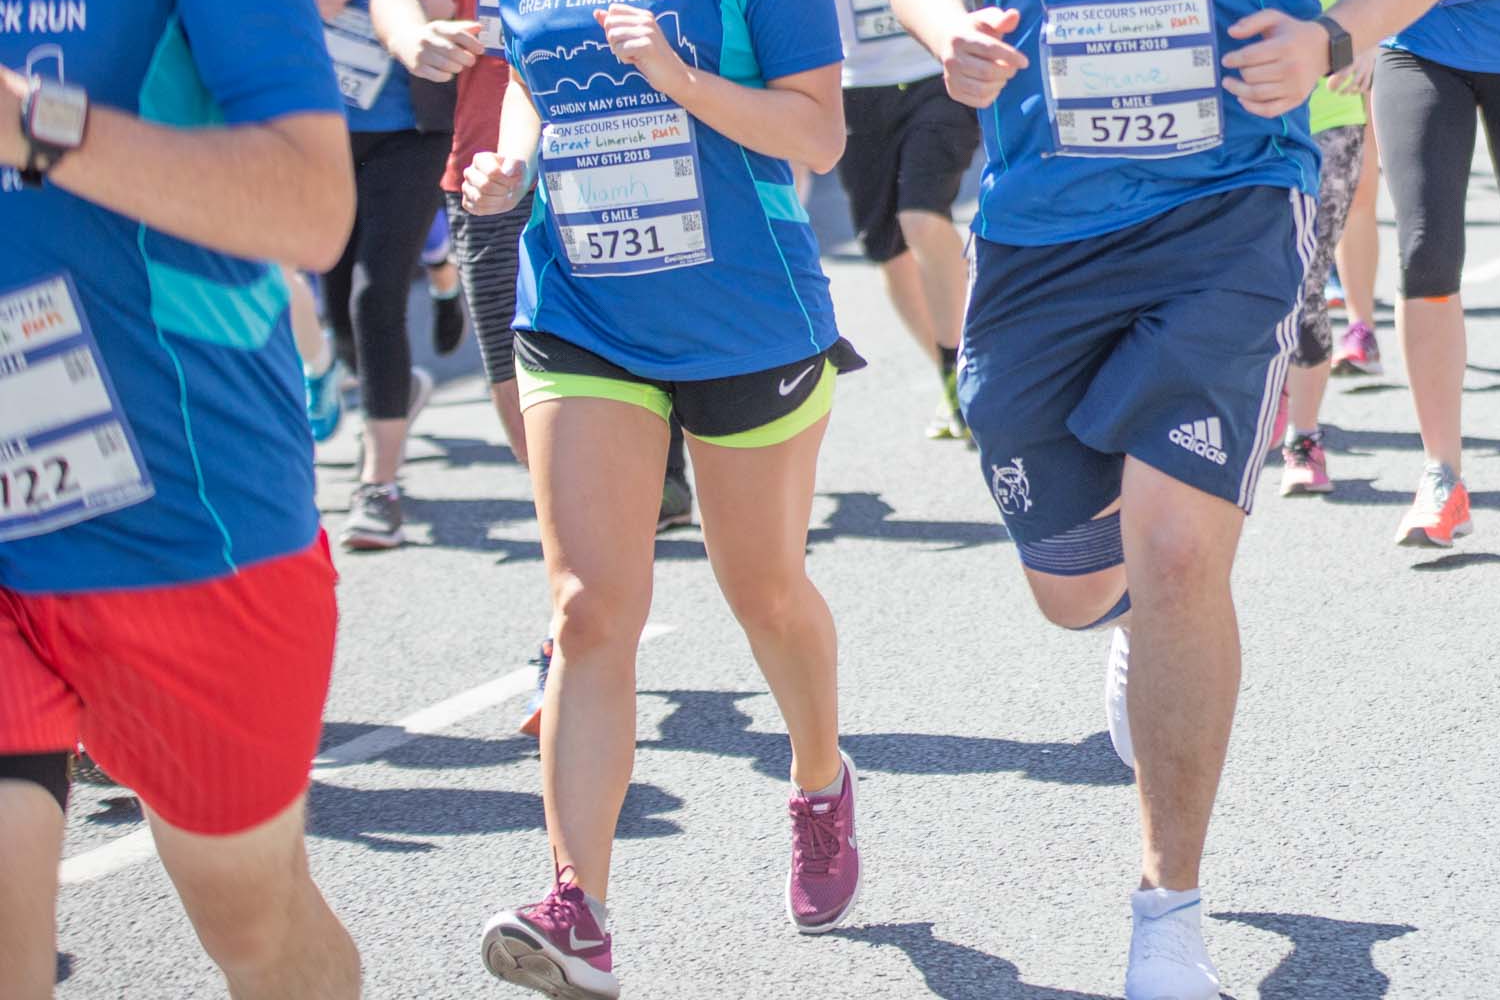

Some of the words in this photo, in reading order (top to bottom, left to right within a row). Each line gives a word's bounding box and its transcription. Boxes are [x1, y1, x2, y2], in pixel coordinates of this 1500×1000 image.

[29, 0, 87, 33] RUN
[1056, 10, 1079, 22] BON
[1083, 6, 1137, 20] SECOURS
[1139, 2, 1199, 16] HOSPITAL
[1055, 24, 1104, 39] Great
[1109, 18, 1164, 34] Limerick
[1086, 42, 1112, 55] MAY
[1113, 40, 1138, 53] 6TH
[1139, 38, 1169, 51] 2018
[550, 102, 586, 117] SUNDAY
[588, 99, 614, 113] MAY
[615, 96, 638, 109] 6TH
[640, 92, 668, 105] 2018
[1122, 96, 1153, 109] MILE
[574, 120, 619, 136] SECOURS
[622, 113, 680, 129] HOSPITAL
[1090, 112, 1179, 143] 5732
[551, 137, 591, 155] Great
[595, 132, 646, 148] Limerick
[576, 154, 599, 169] MAY
[600, 152, 624, 165] 6TH
[624, 149, 651, 163] 2018
[601, 212, 609, 223] 6
[611, 208, 640, 222] MILE
[587, 225, 665, 259] 5731
[1168, 428, 1228, 466] adidas
